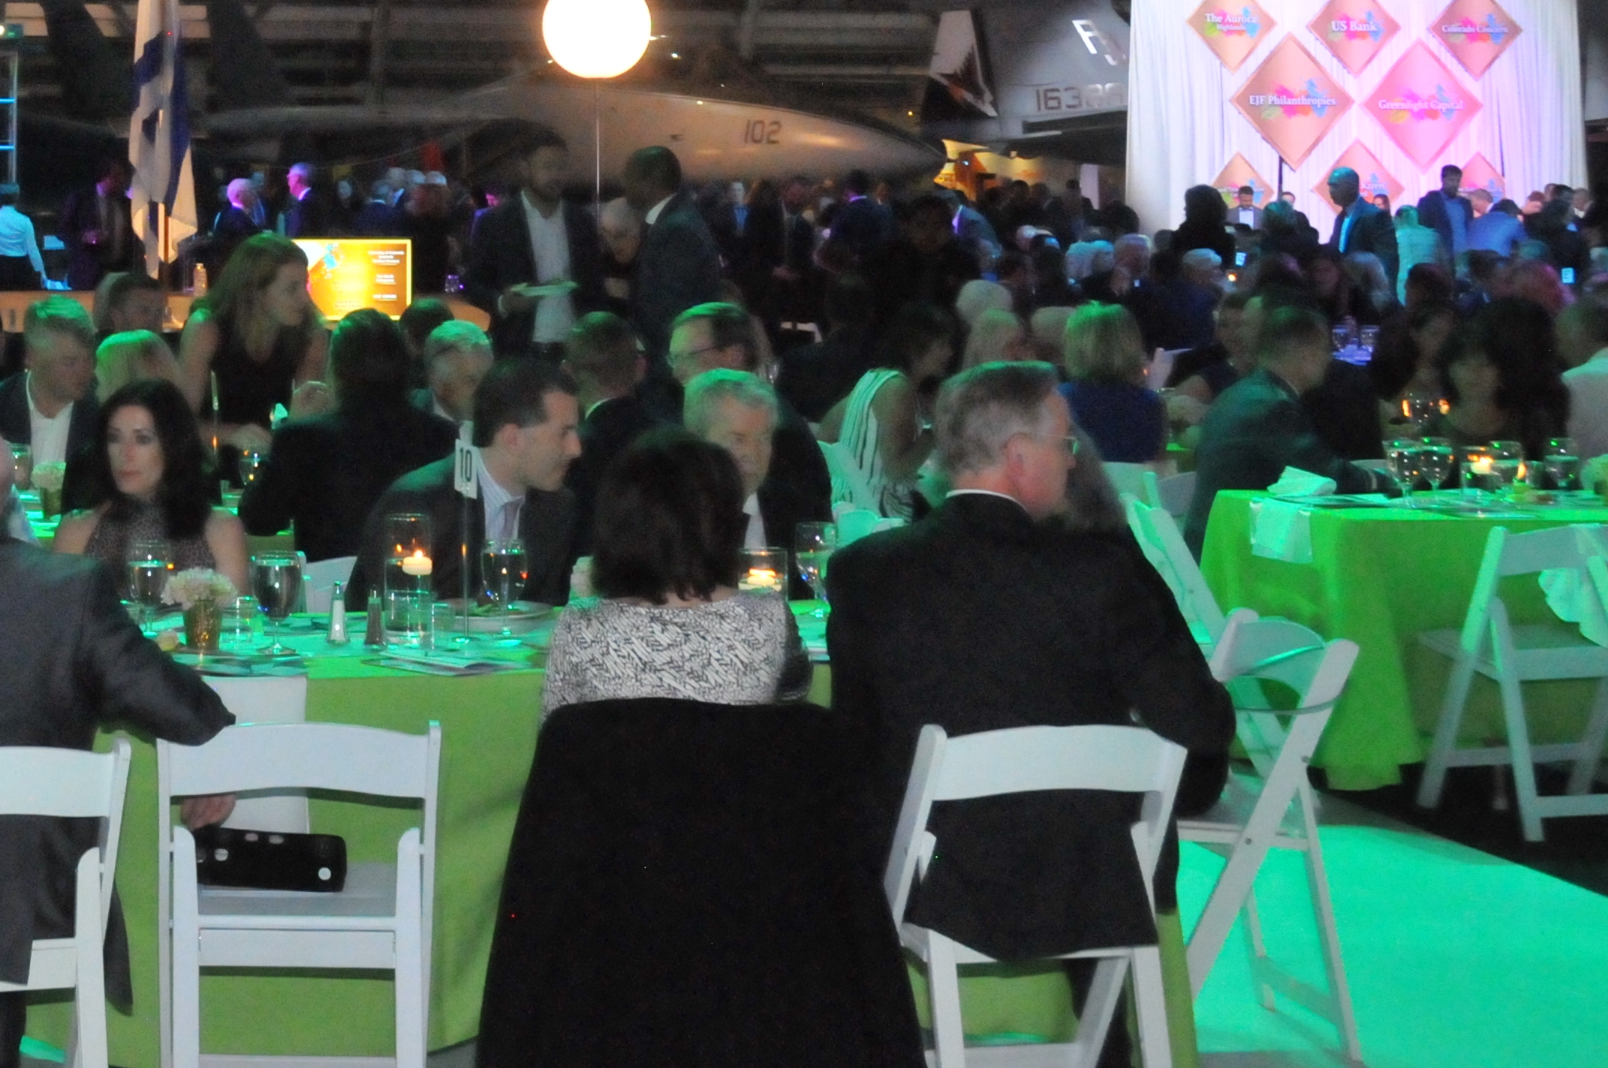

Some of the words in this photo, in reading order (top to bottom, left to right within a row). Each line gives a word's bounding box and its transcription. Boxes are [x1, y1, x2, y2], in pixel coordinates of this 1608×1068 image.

[1204, 12, 1223, 23] The
[1331, 20, 1348, 31] US
[1349, 20, 1378, 32] Bank
[1249, 95, 1267, 106] EJF
[1267, 95, 1337, 108] Philanthropies
[1378, 99, 1429, 112] Greenlight
[1429, 99, 1464, 113] Capital
[744, 119, 782, 145] 102
[459, 447, 472, 482] 10
